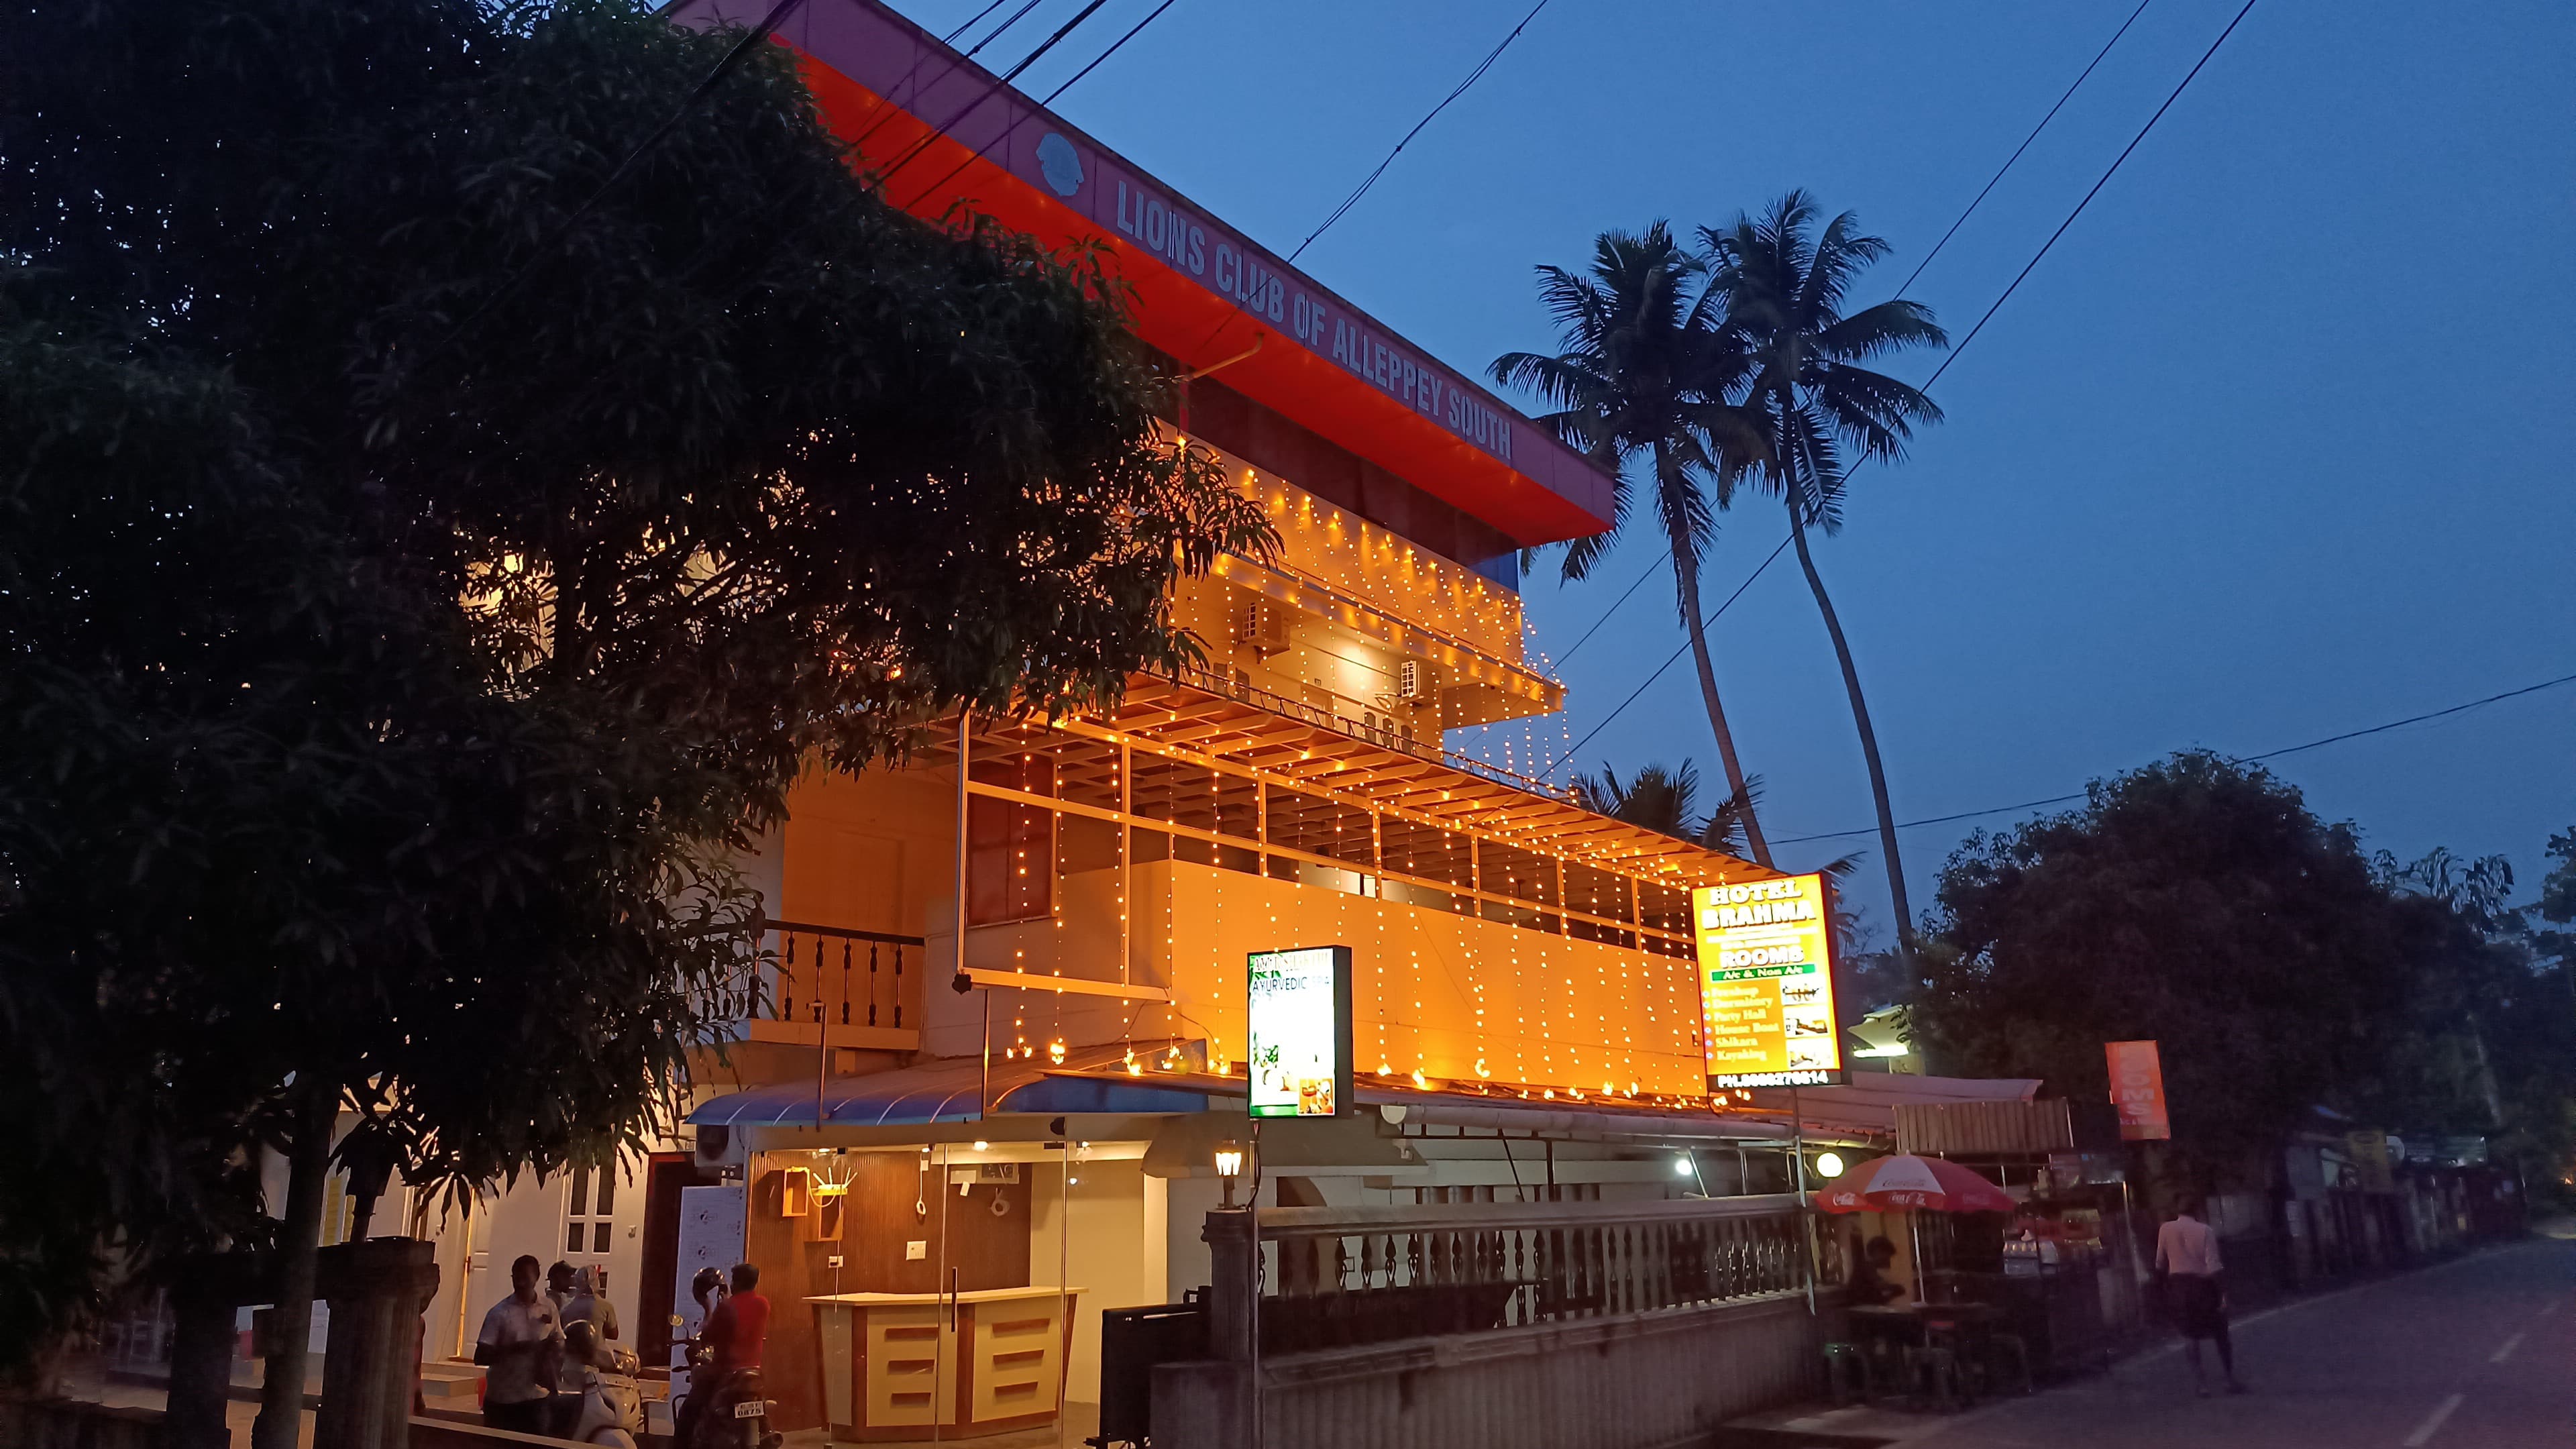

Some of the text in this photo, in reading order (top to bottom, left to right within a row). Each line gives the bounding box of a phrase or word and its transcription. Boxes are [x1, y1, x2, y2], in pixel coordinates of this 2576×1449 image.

[1117, 180, 1512, 460] LIONS CLUB OF ALLEPPEY SOUTH
[1710, 879, 1803, 906] HOTEL
[1702, 900, 1817, 929] BRAHMA
[1719, 946, 1805, 969] ROOMS
[1252, 976, 1308, 993] AYURVEDIC
